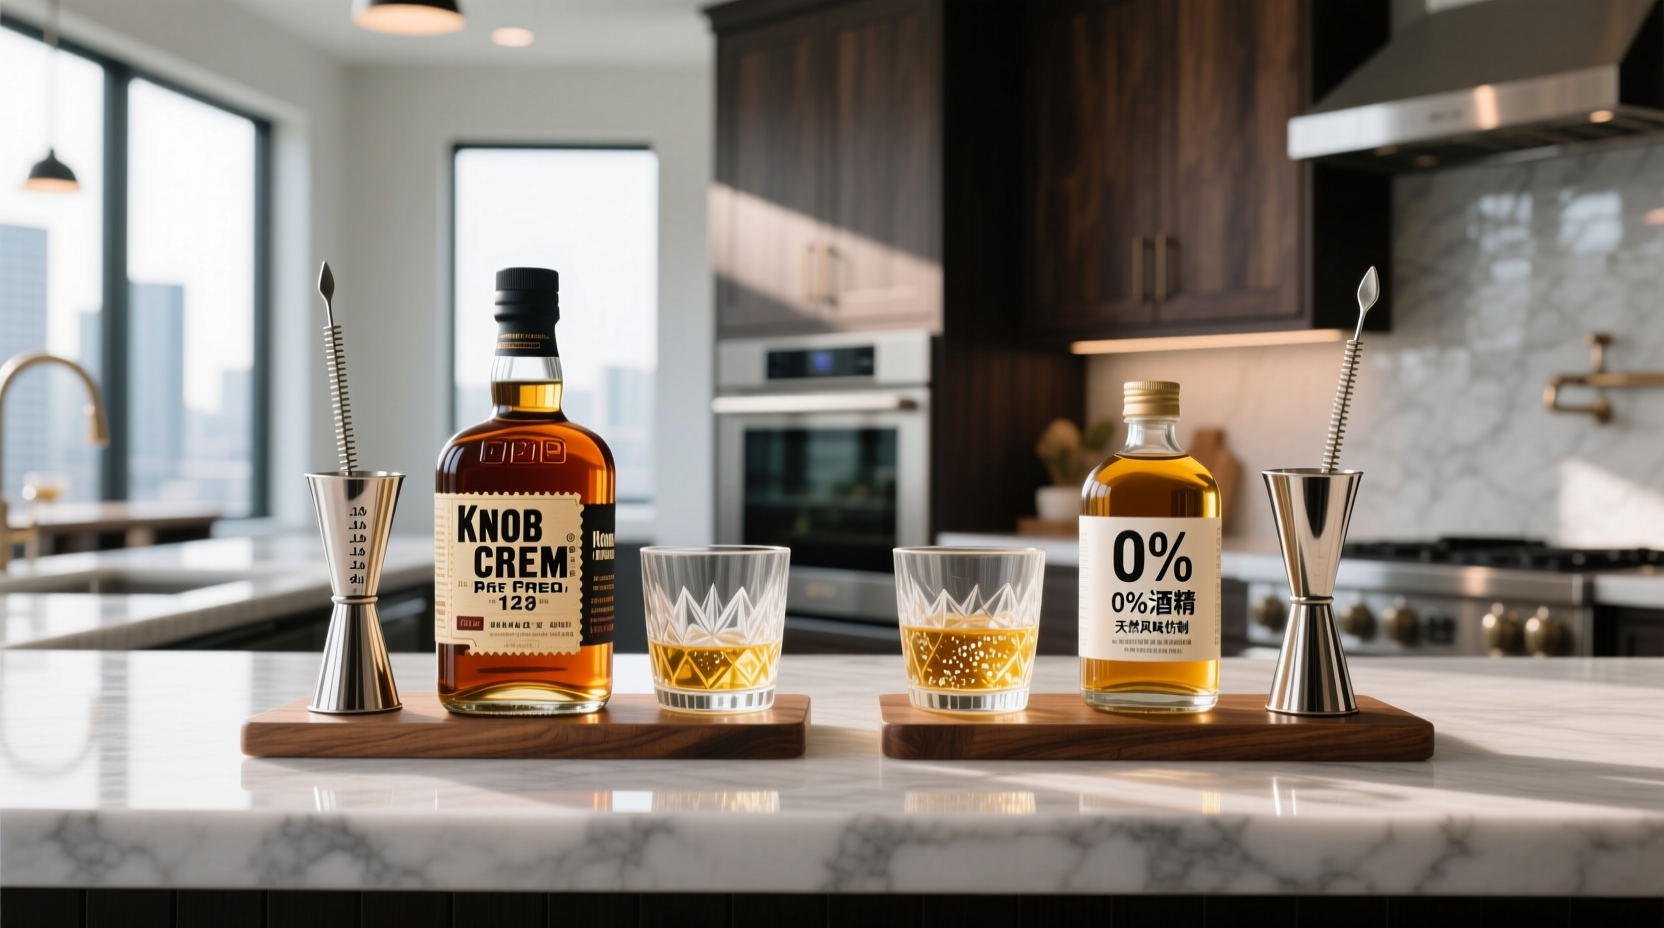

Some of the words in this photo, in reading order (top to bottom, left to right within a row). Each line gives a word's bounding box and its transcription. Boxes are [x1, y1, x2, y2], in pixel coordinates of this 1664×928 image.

[458, 505, 542, 543] KNOB
[474, 546, 568, 579] CREM
[1113, 529, 1193, 583] 0%
[1111, 589, 1196, 616] 0%酒精
